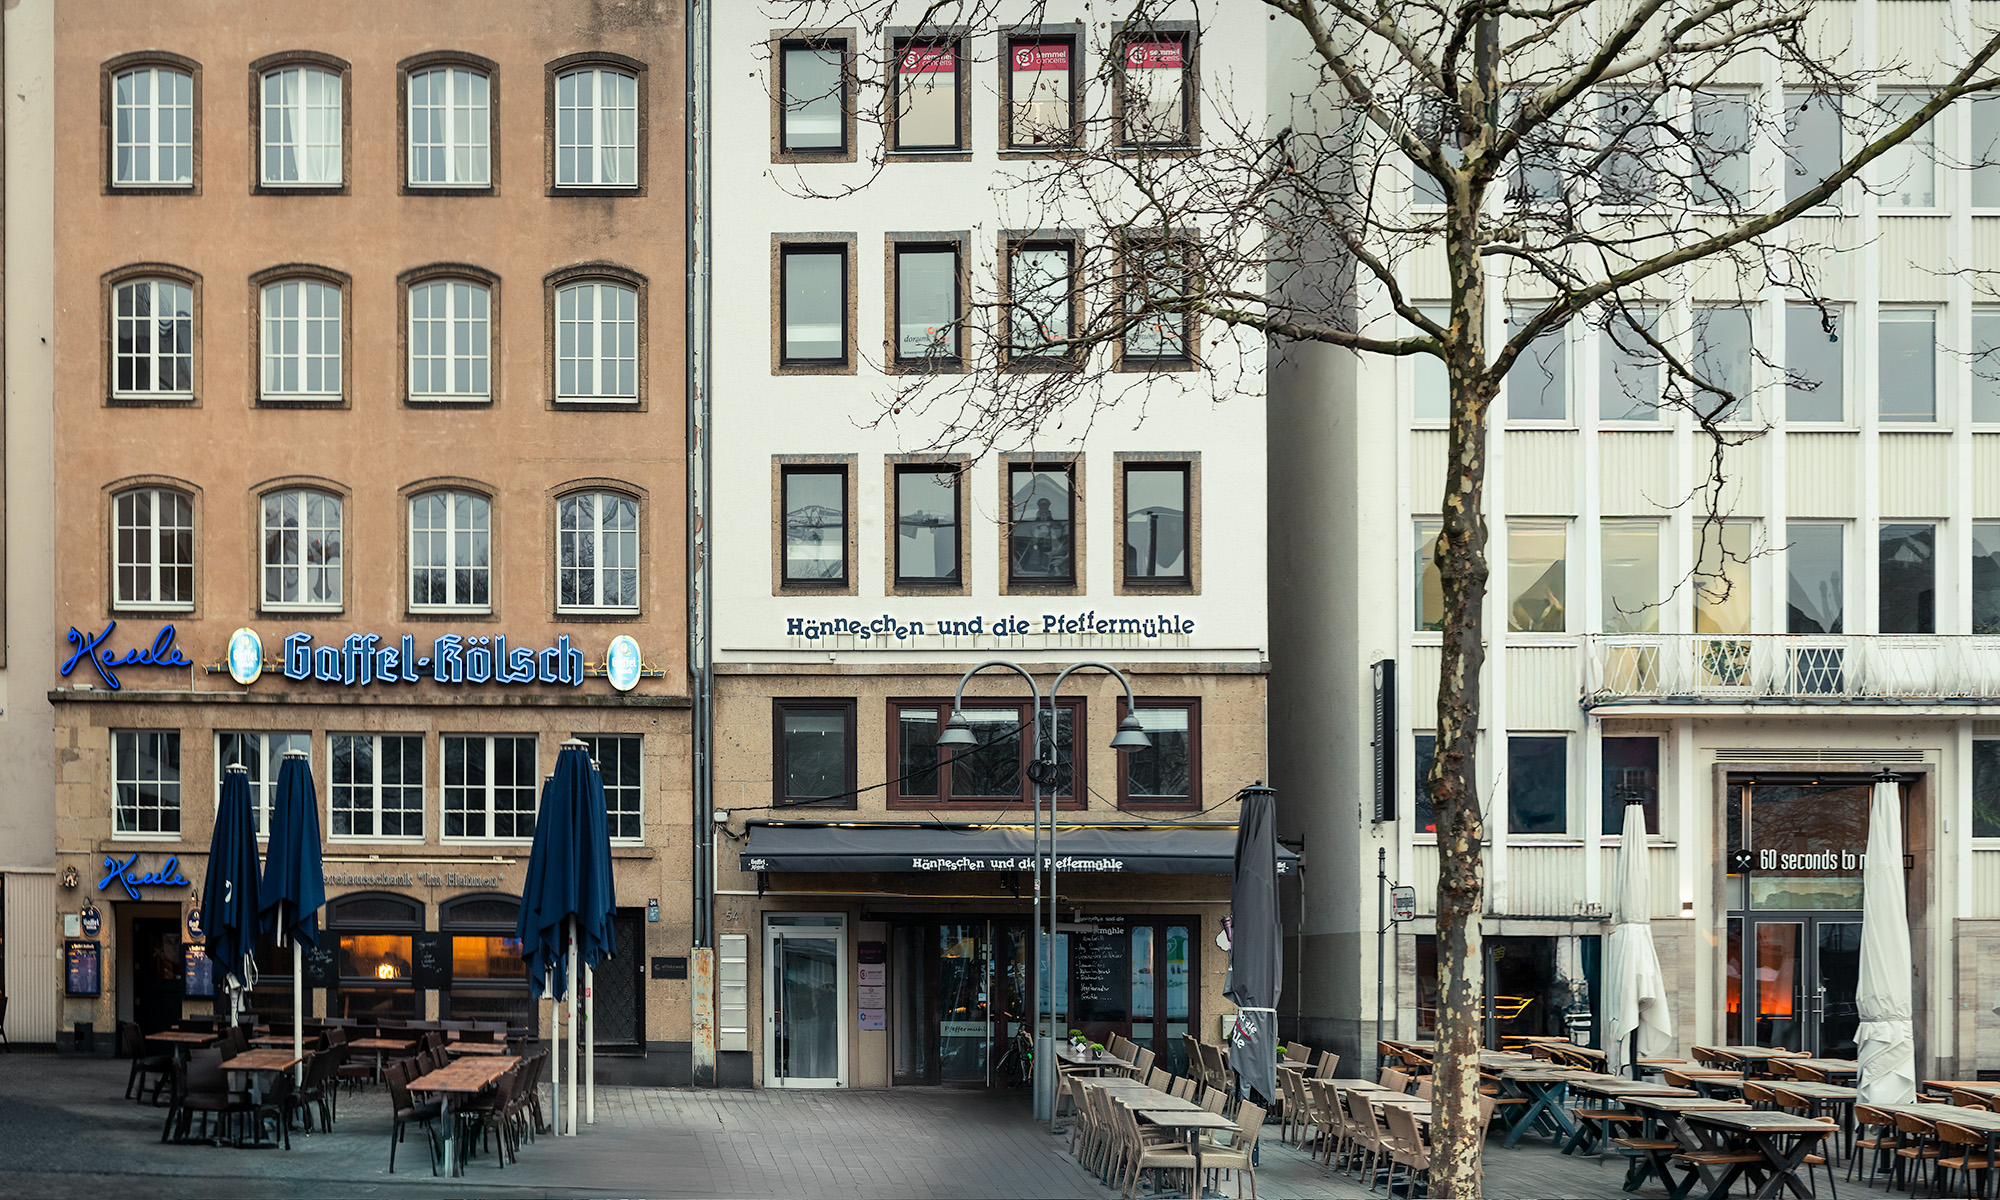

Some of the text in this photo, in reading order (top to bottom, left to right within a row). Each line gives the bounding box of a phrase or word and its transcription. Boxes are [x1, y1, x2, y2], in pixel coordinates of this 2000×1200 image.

[787, 611, 1195, 639] Hänneschen und die Pfeffermühle
[60, 620, 194, 690] Keule
[284, 631, 584, 686] Gaffel-Kölsch
[913, 857, 984, 870] Hänneschen
[990, 858, 1014, 868] und
[1044, 857, 1123, 871] Peffermühle
[1760, 849, 1777, 870] 60
[1781, 849, 1838, 870] seconds
[1841, 849, 1855, 870] to
[725, 911, 738, 922] 54
